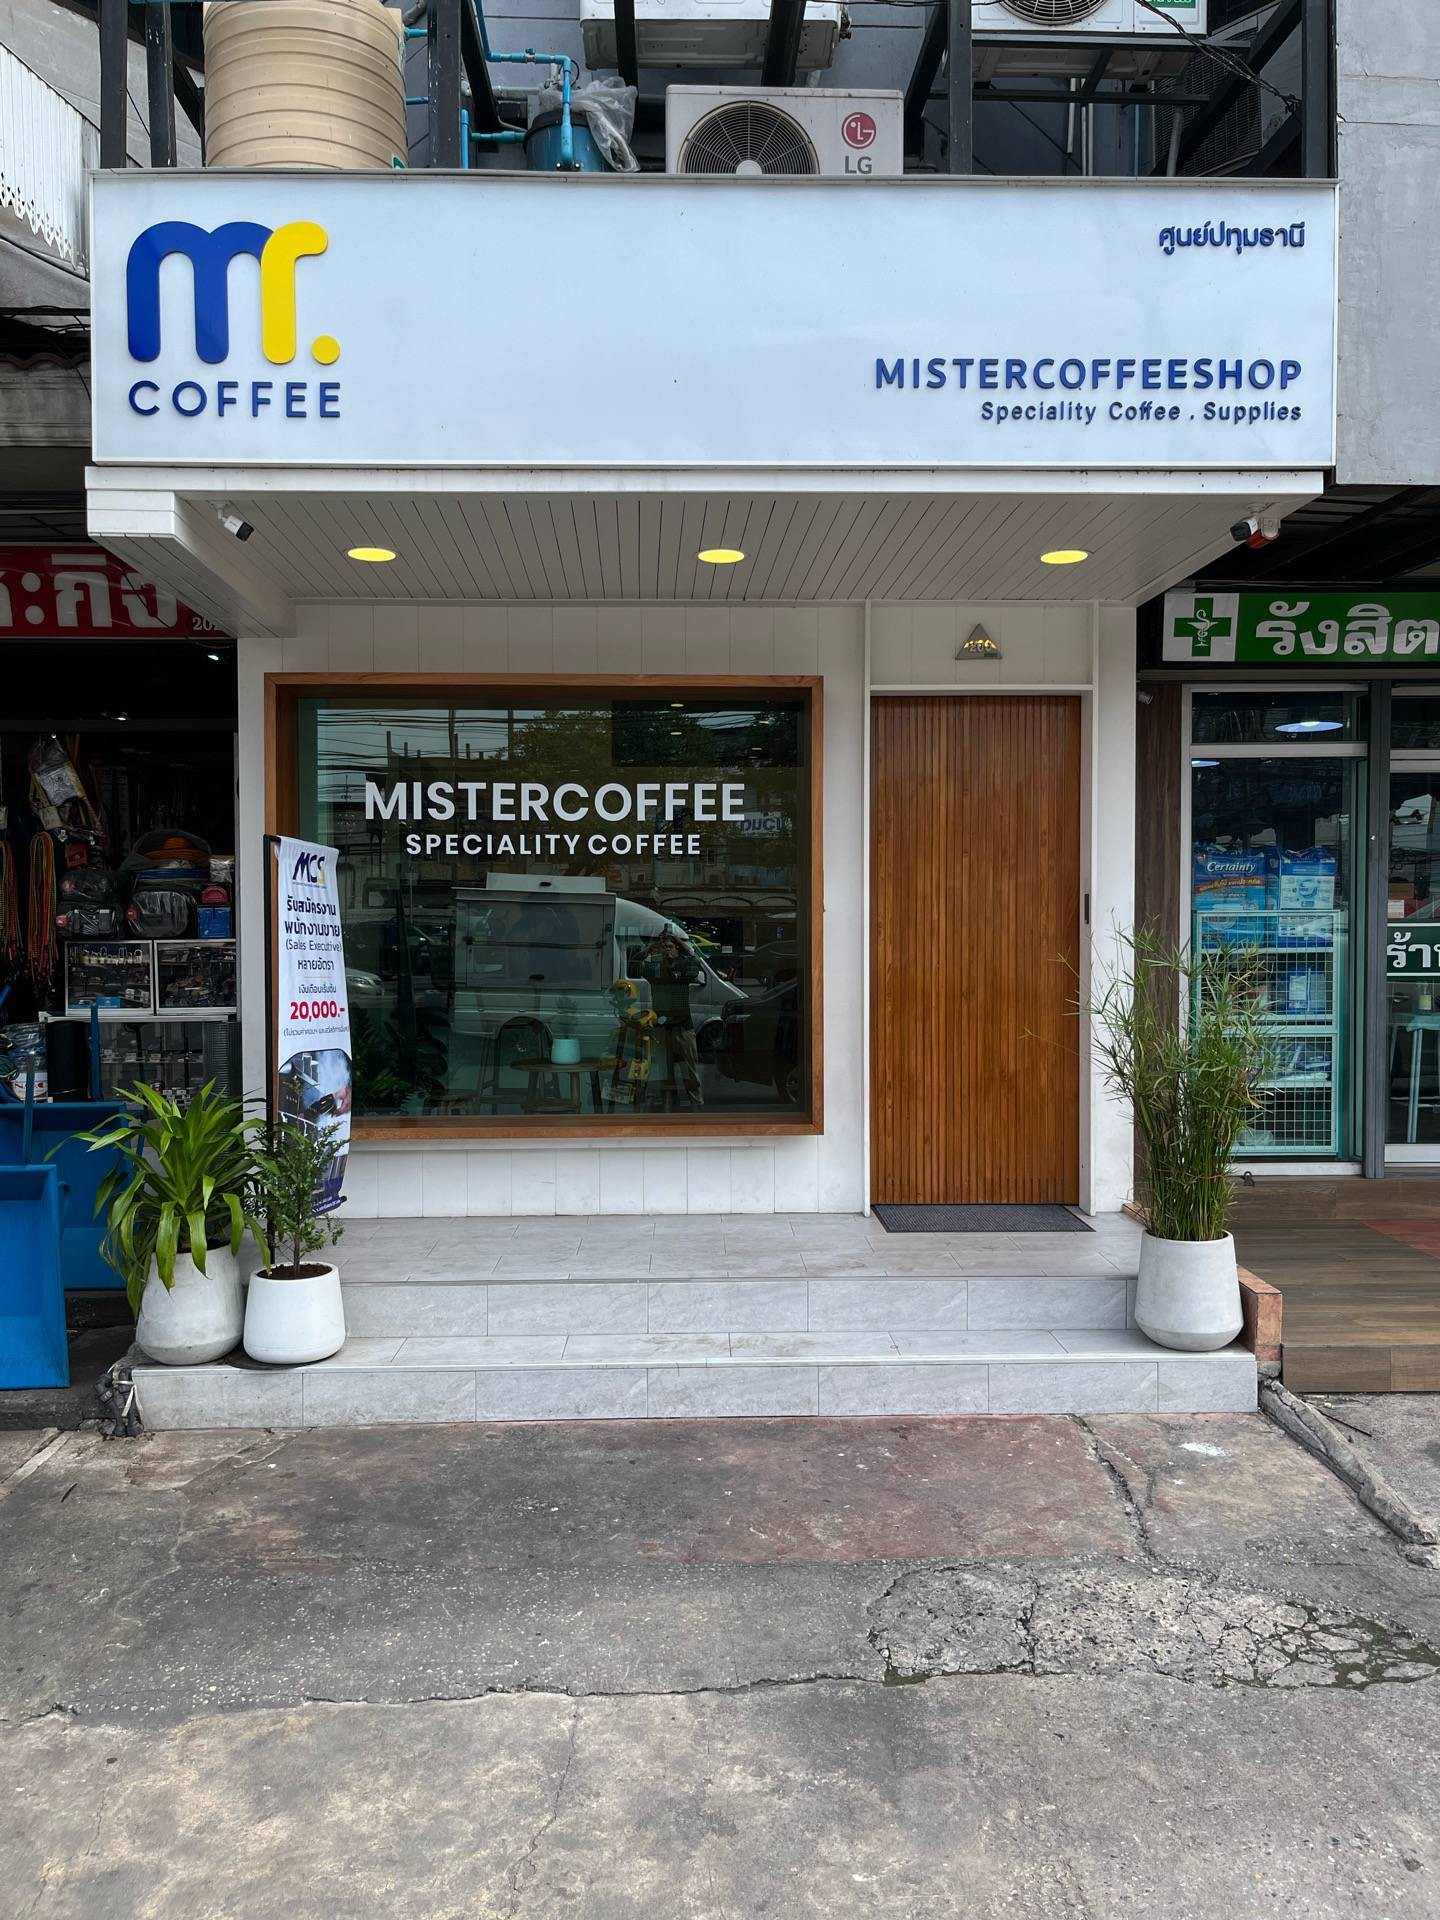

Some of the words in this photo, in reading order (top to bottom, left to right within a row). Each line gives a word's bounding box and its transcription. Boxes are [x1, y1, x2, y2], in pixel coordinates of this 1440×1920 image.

[845, 155, 872, 174] LG
[1159, 220, 1305, 256] ศูนย์ปทุมธานี
[875, 358, 1302, 390] MISTERCOFFEESHOP
[128, 380, 341, 418] COFFEE
[980, 400, 1097, 425] Speciality
[1108, 401, 1181, 421] Coffee
[1203, 401, 1302, 425] Supplies
[1256, 600, 1440, 656] รังสิต
[365, 781, 746, 822] MISTERCOFFEE
[406, 833, 580, 856] SPECIALITY
[588, 834, 701, 856] COFFEE
[1206, 861, 1256, 873] Certainty
[287, 894, 337, 916] รับสมัครงาน
[284, 917, 341, 938] พนักงานขาย
[297, 956, 335, 971] หลายอัตรา
